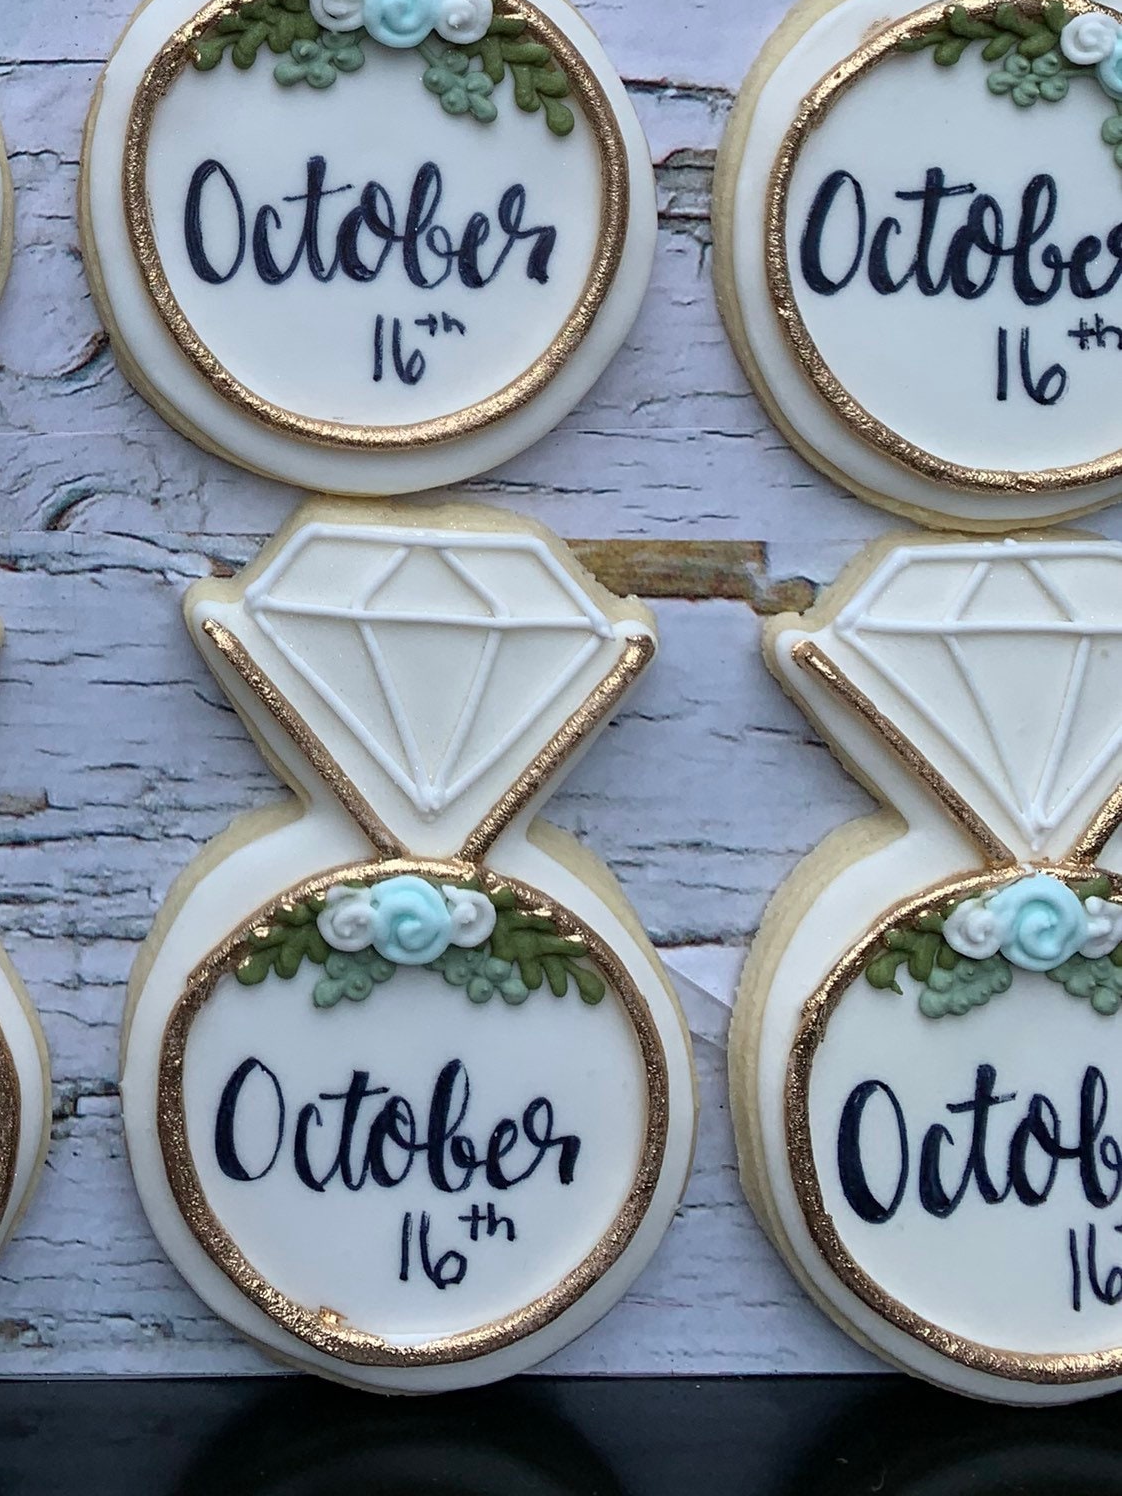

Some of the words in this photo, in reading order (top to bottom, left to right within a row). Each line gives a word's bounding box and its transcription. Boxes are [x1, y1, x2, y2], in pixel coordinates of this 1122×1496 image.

[183, 155, 557, 290] October
[372, 311, 466, 386] 16th
[996, 312, 1122, 407] 16th
[214, 1056, 582, 1194] October
[836, 1063, 1122, 1225] Octob
[398, 1201, 517, 1291] 16th
[1068, 1222, 1122, 1311] 16
